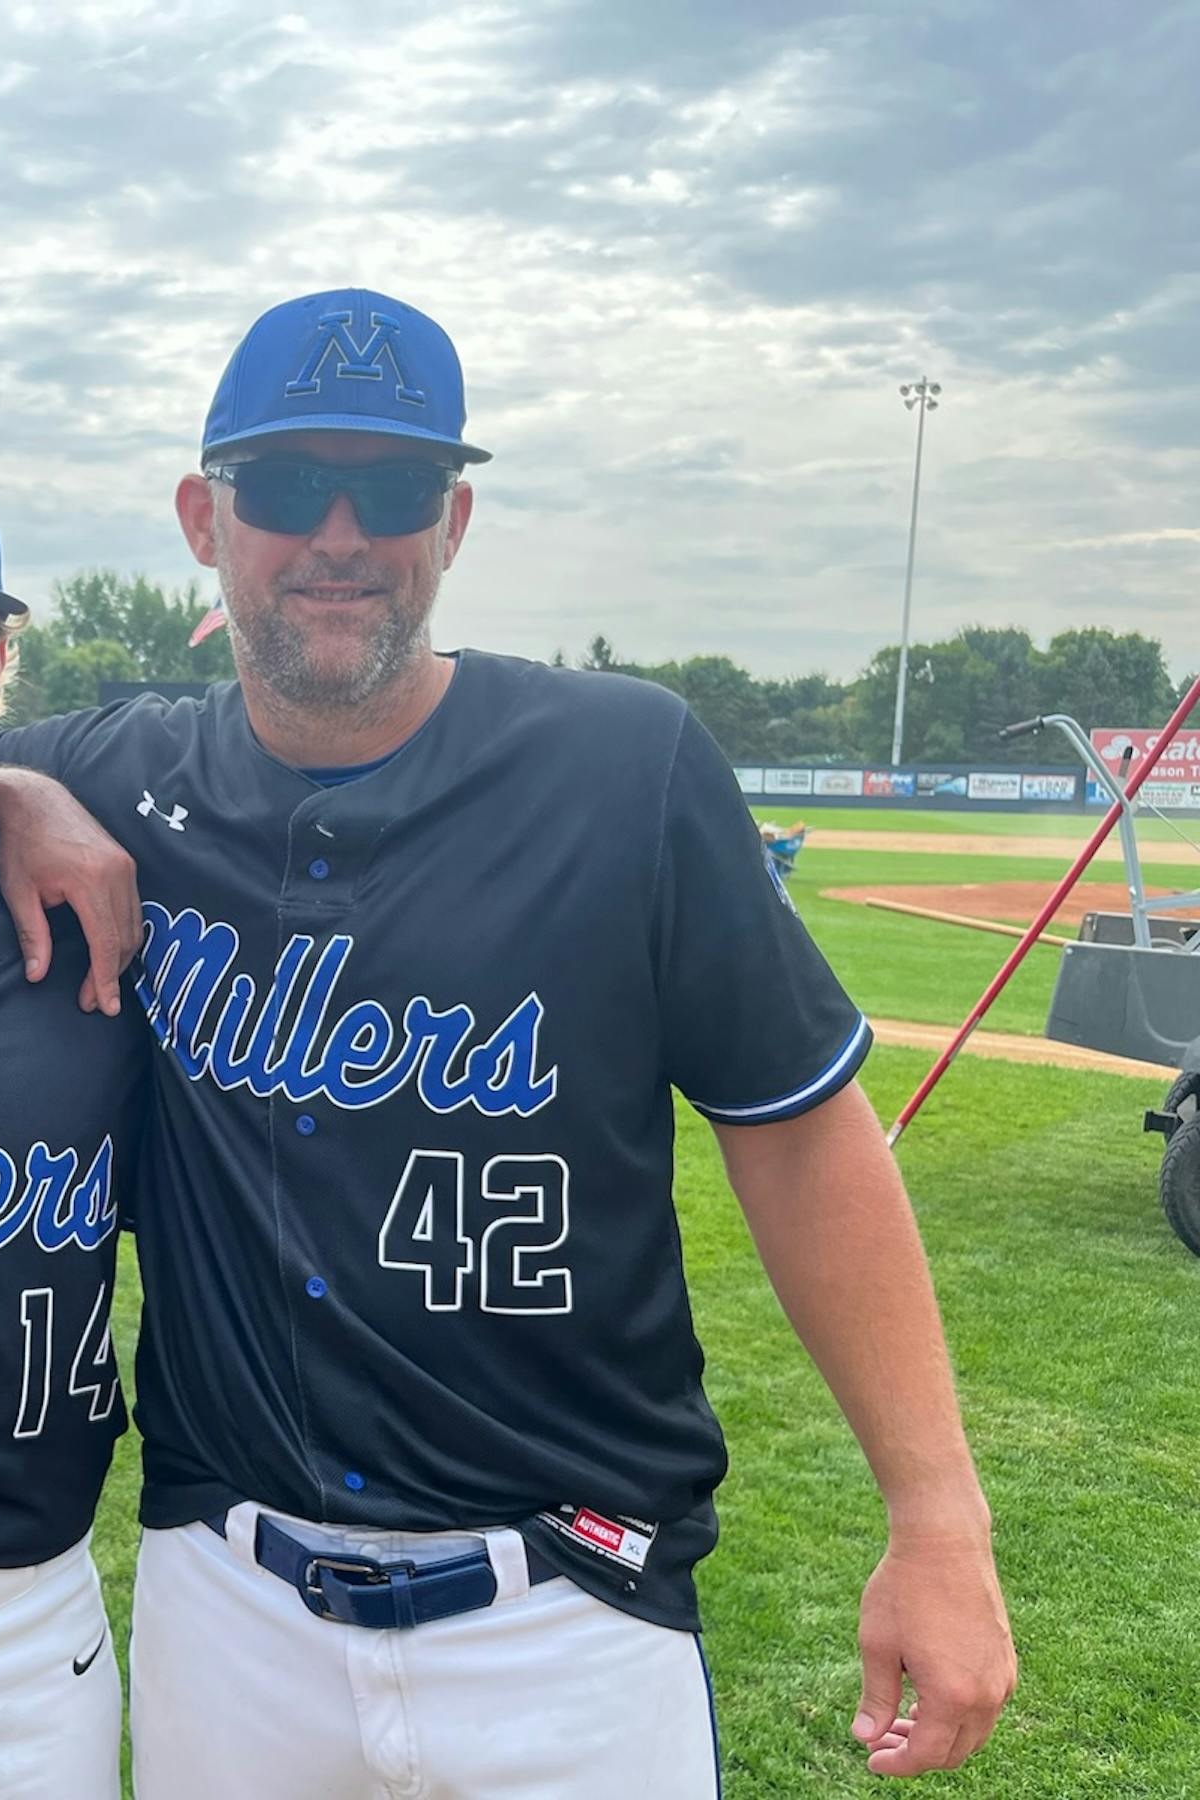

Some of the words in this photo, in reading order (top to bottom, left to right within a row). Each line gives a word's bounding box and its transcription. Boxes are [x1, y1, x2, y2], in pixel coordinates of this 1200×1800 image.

[285, 310, 425, 407] M
[1150, 766, 1185, 777] ason
[134, 901, 558, 1117] Millers
[378, 1149, 573, 1315] 42
[12, 1279, 119, 1440] 14
[577, 1515, 621, 1547] AUTHENTIC
[627, 1542, 641, 1556] XL
